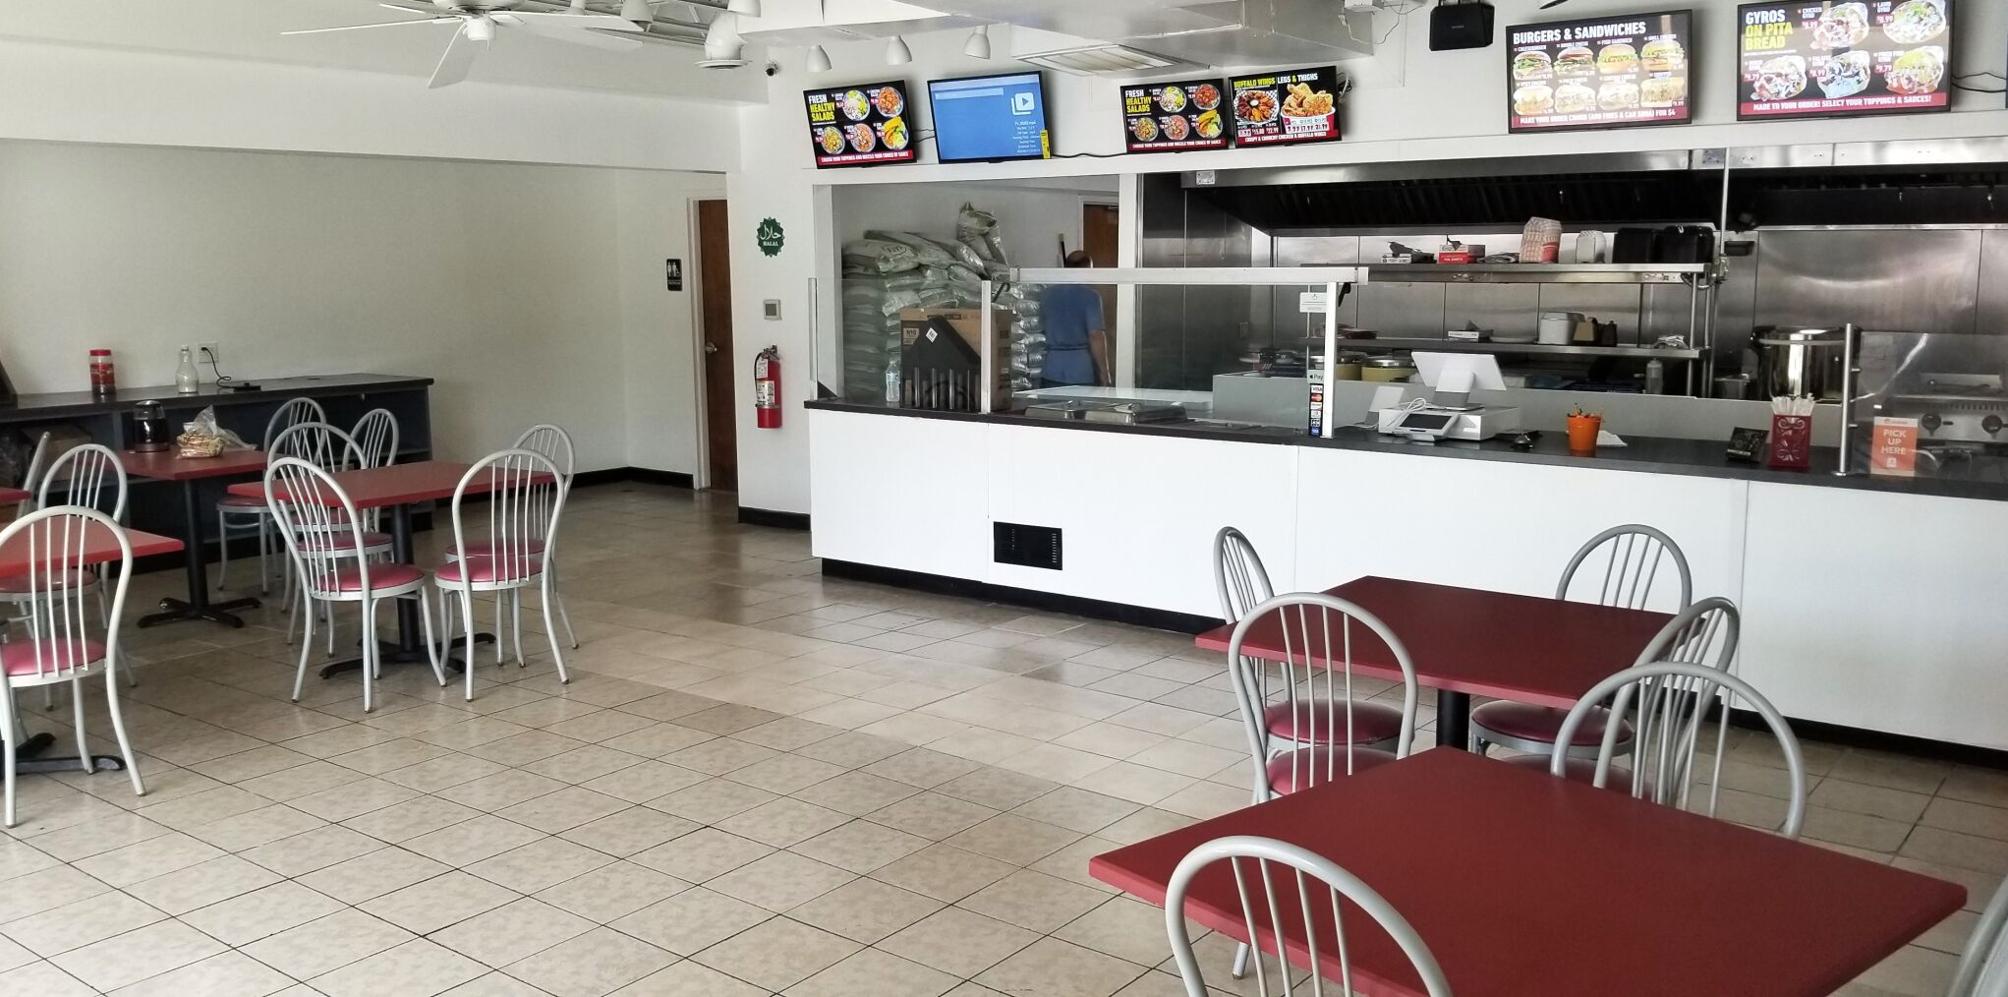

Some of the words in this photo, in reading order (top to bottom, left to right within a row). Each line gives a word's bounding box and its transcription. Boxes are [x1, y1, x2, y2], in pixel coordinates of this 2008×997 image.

[1745, 9, 1786, 25] GYROS
[1513, 29, 1561, 45] BURGERS
[1564, 28, 1573, 40] &
[1574, 21, 1646, 39] SANDWICHES
[1745, 24, 1762, 37] ON
[1765, 22, 1793, 36] PITA
[1745, 36, 1786, 51] BREAD
[1258, 77, 1275, 86] WINGS
[1278, 75, 1291, 84] LEGS
[1297, 73, 1318, 82] THIGHS
[1125, 89, 1144, 98] FRESH
[808, 94, 828, 104] FRESH
[1126, 96, 1151, 106] HEALTHY
[1822, 99, 1845, 107] SELECT
[810, 102, 836, 113] HEALTHY
[1127, 104, 1151, 113] SALADS
[812, 111, 835, 122] SALADS
[760, 224, 782, 240] حلال
[1883, 429, 1907, 438] PICK
[1887, 438, 1902, 446] UP
[1880, 446, 1907, 455] HERE
